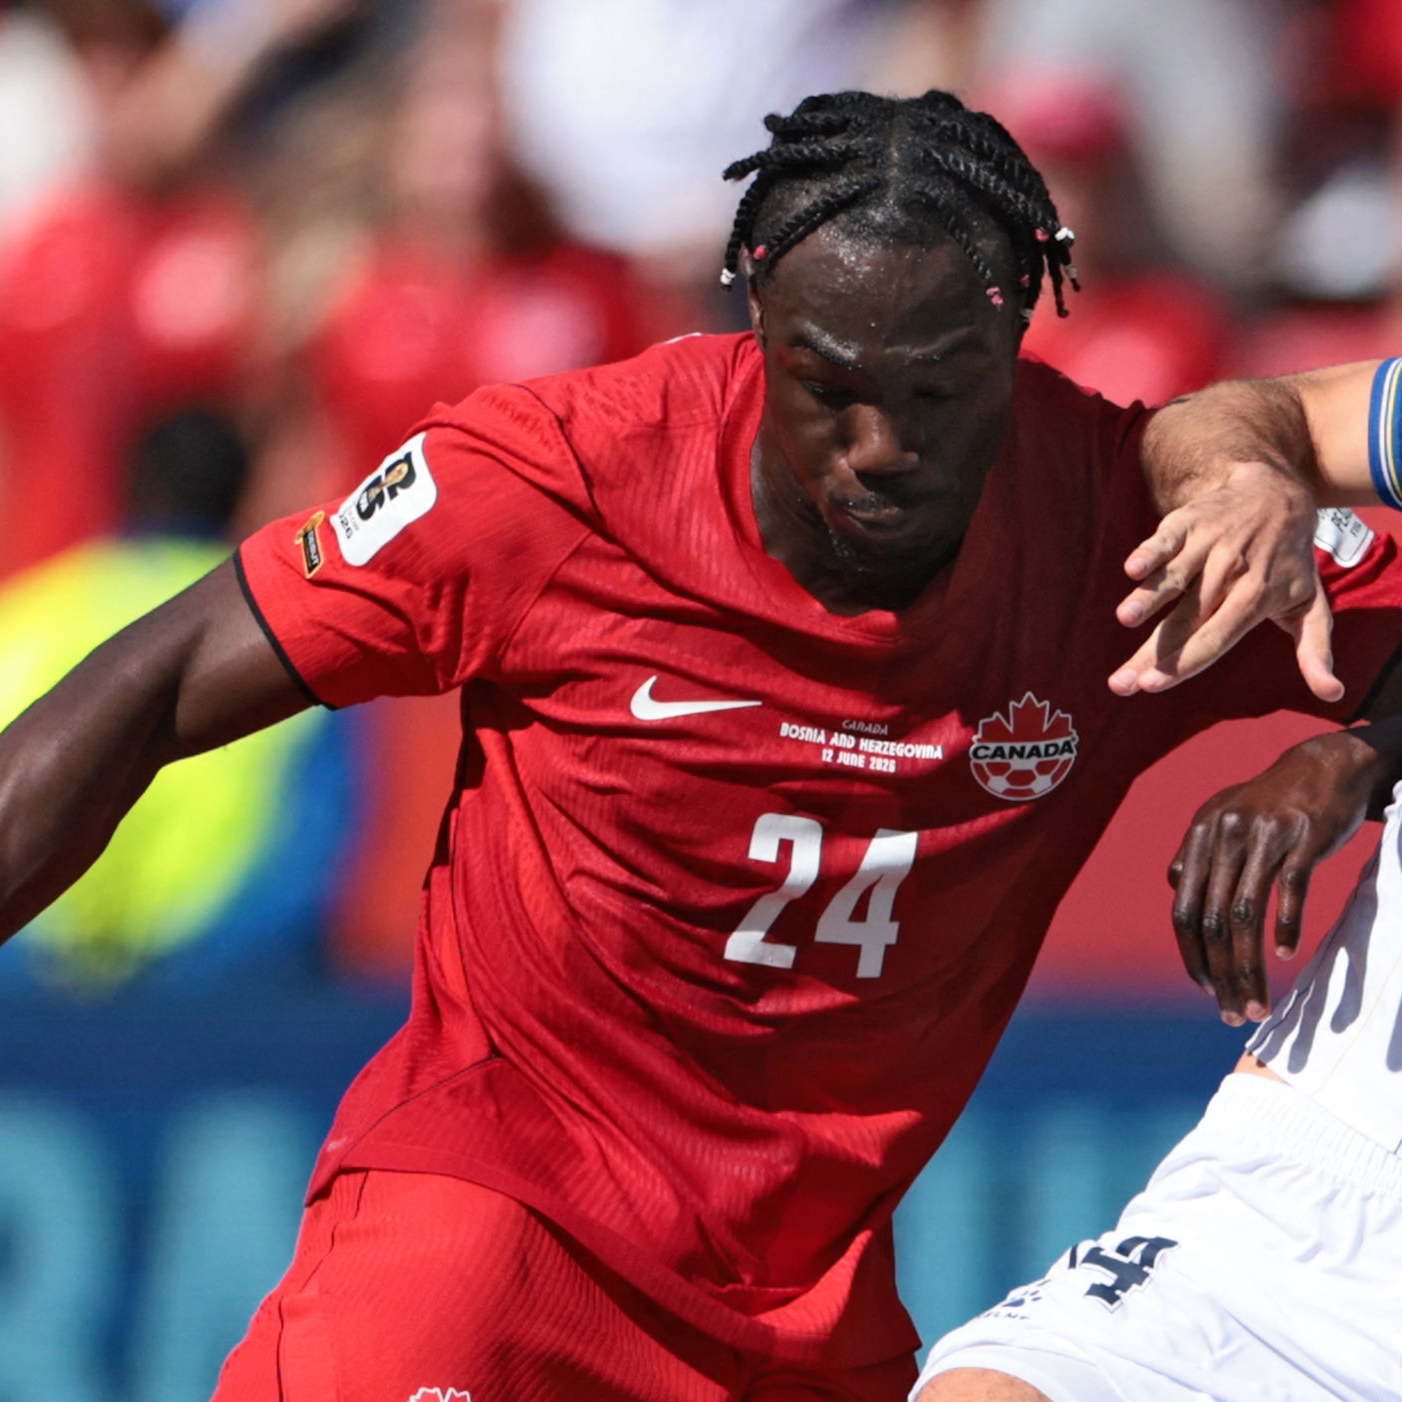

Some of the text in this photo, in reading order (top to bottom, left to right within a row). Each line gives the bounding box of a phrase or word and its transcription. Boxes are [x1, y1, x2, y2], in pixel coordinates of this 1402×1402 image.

[841, 719, 889, 736] CANADA
[779, 722, 944, 760] BOSNIA AND HERZEGOVINA
[971, 740, 1074, 760] CANADA
[821, 748, 896, 773] 12 JUNE 2026
[723, 812, 919, 978] 24
